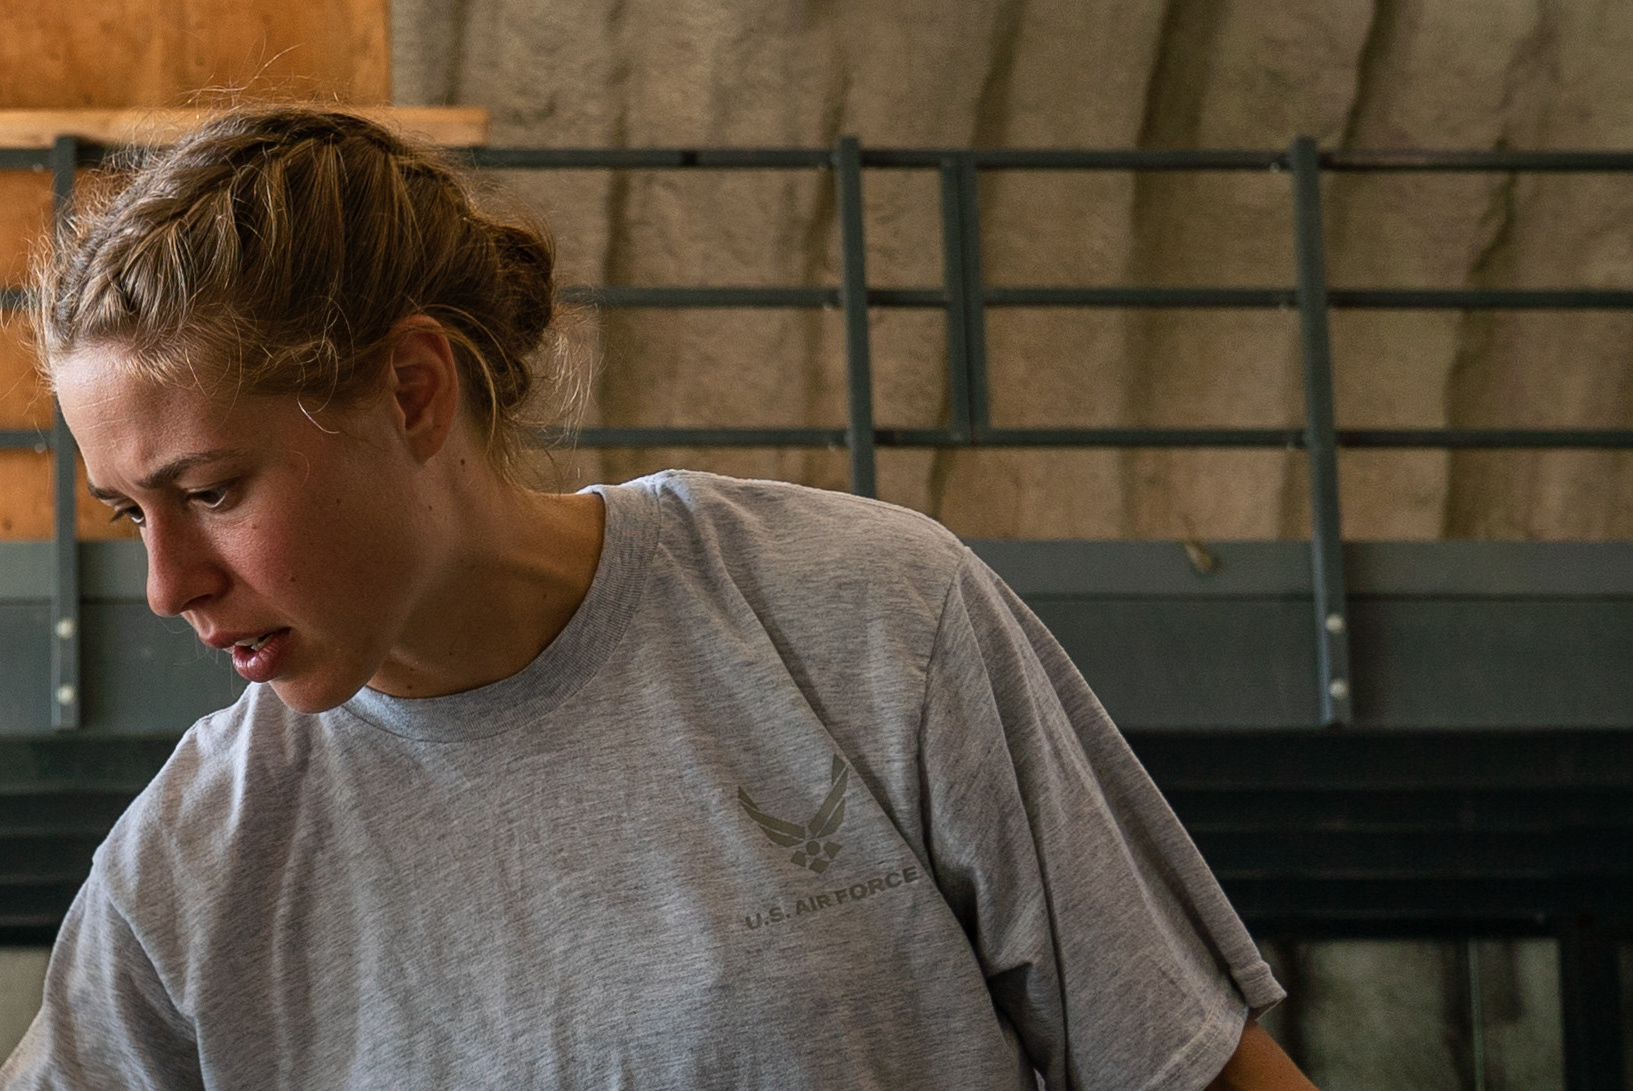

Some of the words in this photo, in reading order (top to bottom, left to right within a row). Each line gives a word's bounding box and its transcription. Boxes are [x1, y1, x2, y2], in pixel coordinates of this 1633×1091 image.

[745, 906, 791, 930] U.S.
[795, 894, 832, 915] AIR
[835, 865, 920, 904] FORCE
